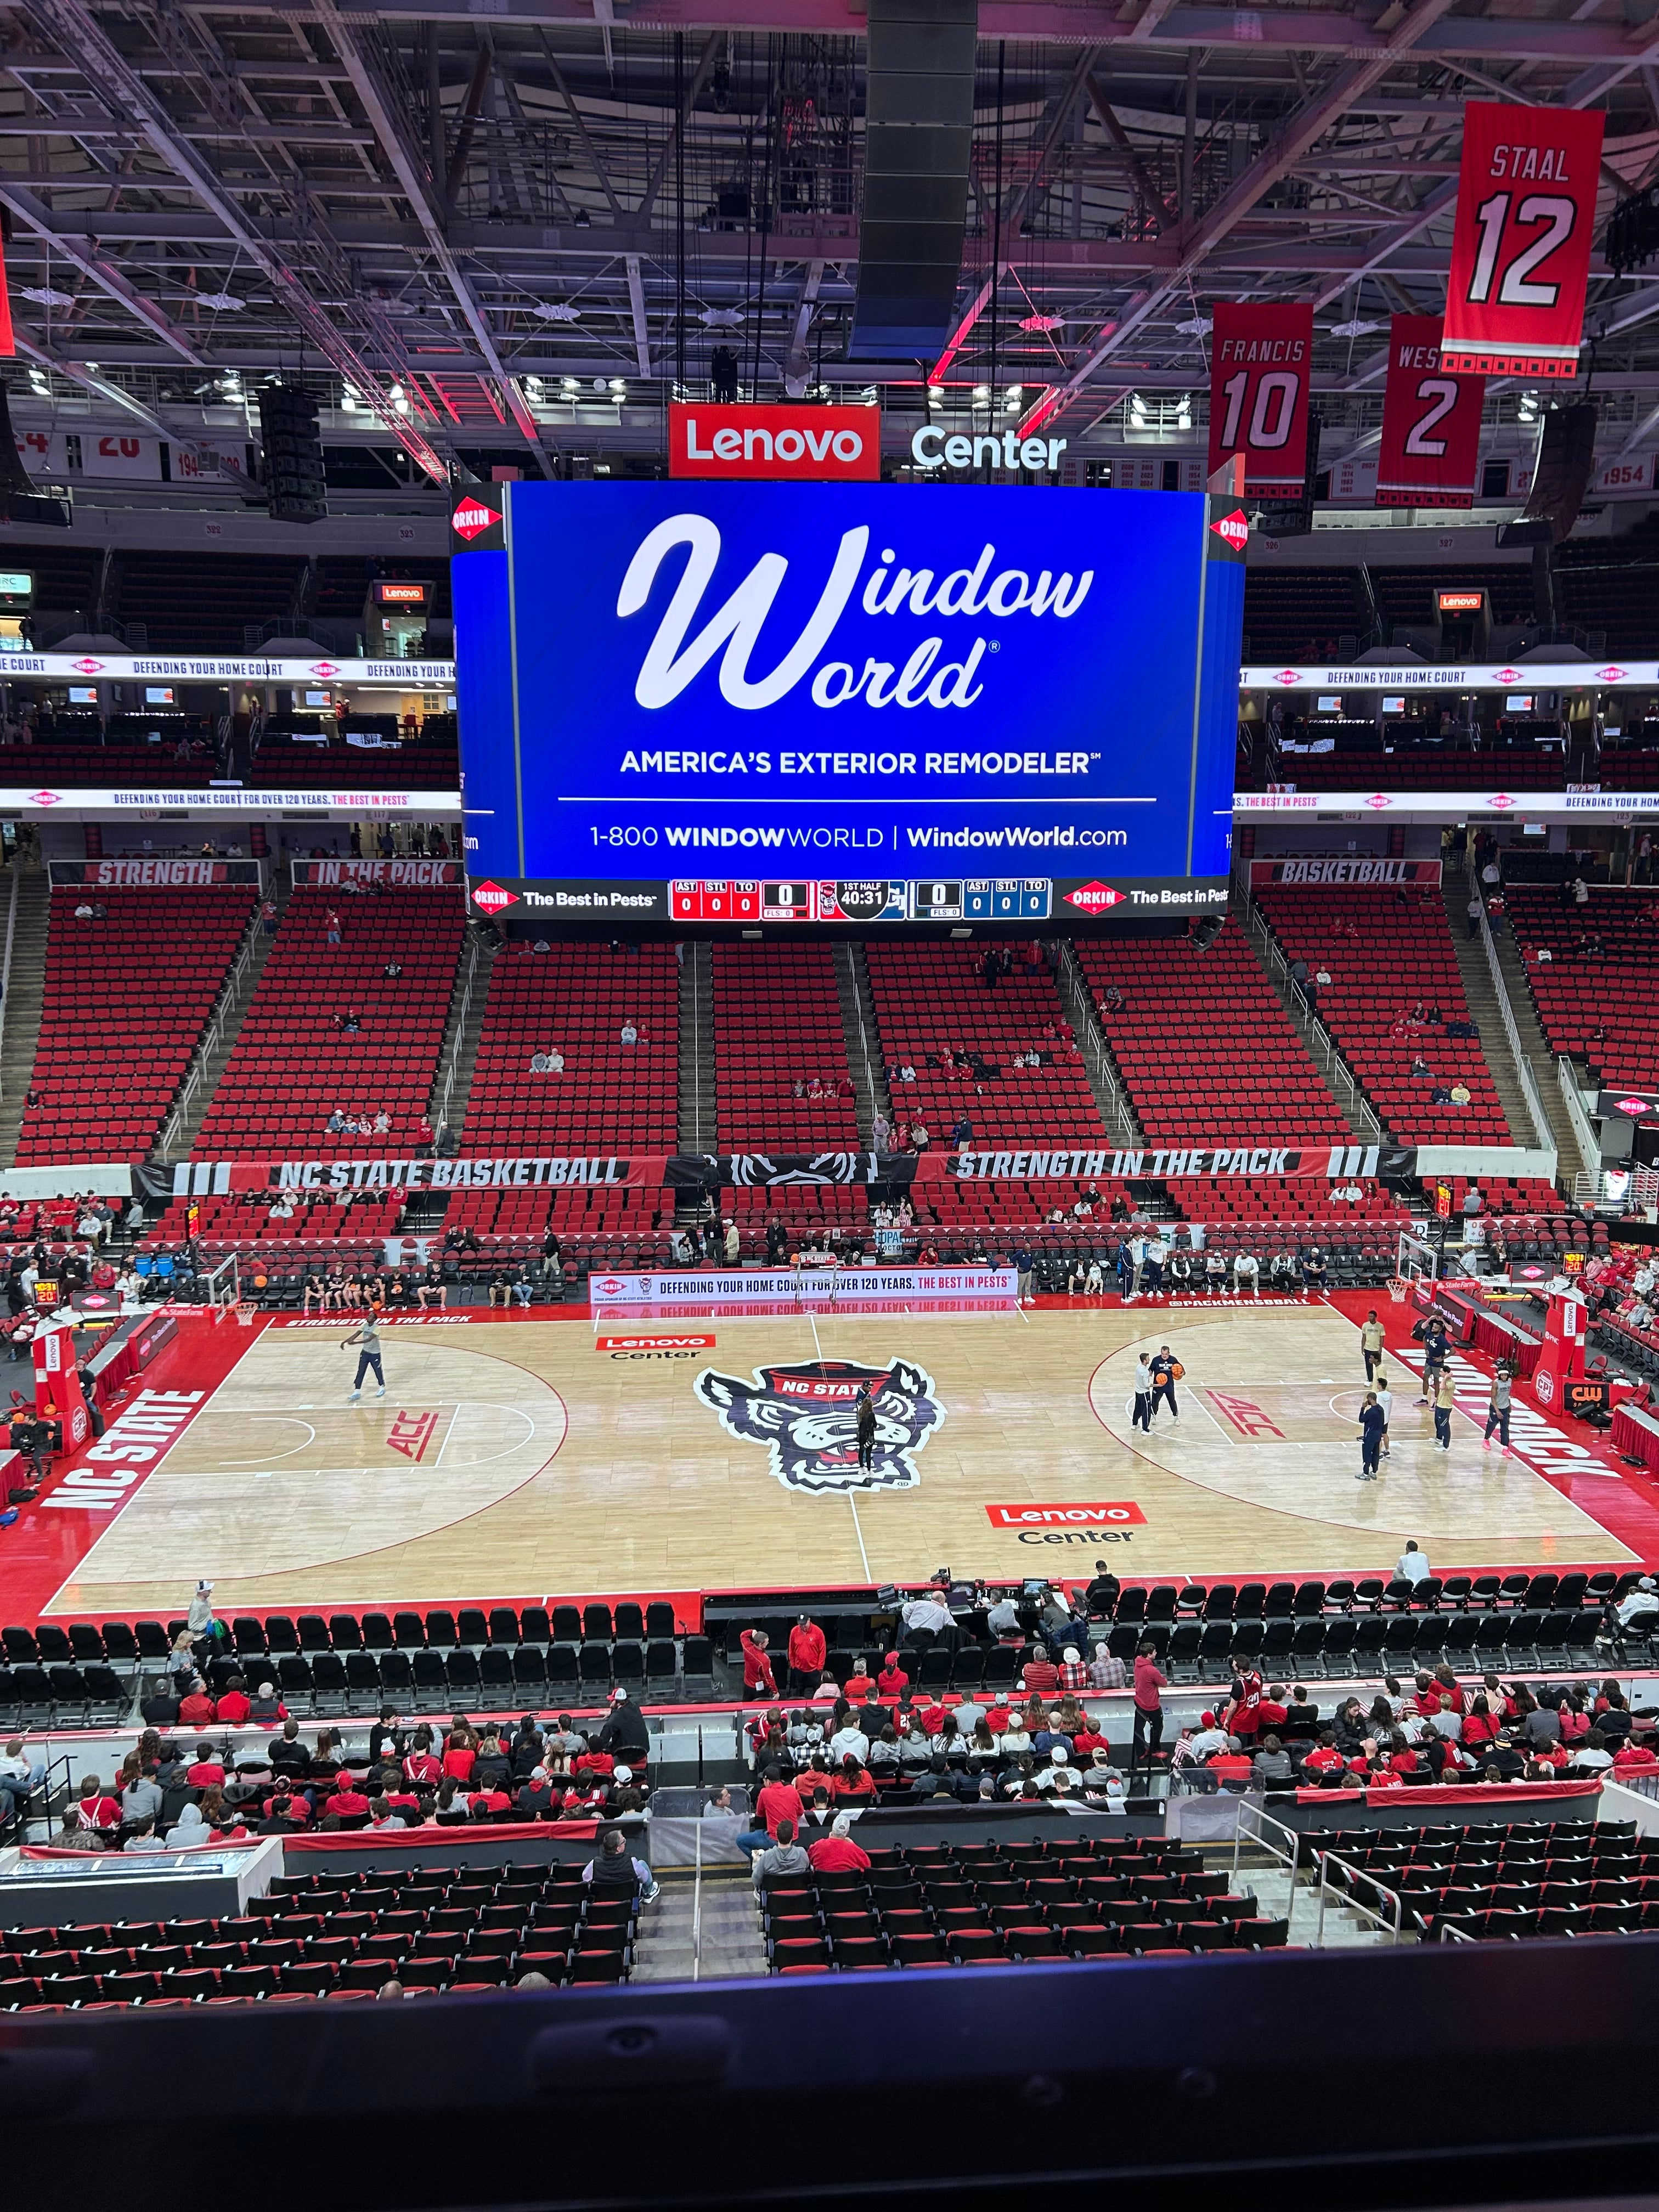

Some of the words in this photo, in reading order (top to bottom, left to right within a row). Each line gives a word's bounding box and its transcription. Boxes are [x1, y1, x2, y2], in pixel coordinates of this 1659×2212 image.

[1491, 145, 1570, 182] STAAL
[1466, 190, 1578, 308] 12
[1220, 339, 1305, 363] FRANCIS
[1220, 371, 1300, 450] 10
[1403, 379, 1459, 456] 2
[686, 420, 863, 462] Lenovo
[911, 425, 1068, 471] Center
[1604, 465, 1644, 484] 1954
[453, 509, 489, 529] ORKIN
[206, 525, 222, 534] 322
[399, 528, 415, 538] 323
[1266, 540, 1278, 549] 326
[1439, 539, 1453, 547] 327
[385, 588, 421, 598] Lenovo
[1443, 596, 1477, 607] Lenovo
[11, 659, 45, 672] COURT
[76, 662, 101, 670] ORKIN
[133, 662, 187, 674] DEFENDING
[190, 662, 216, 674] YOUR
[218, 663, 246, 675] HOME
[249, 663, 283, 675] COURT
[313, 666, 336, 674] ORKIN
[367, 664, 419, 677] DEFENDING
[421, 665, 445, 678] YOUR
[1277, 673, 1299, 681] ORKIN
[1328, 672, 1375, 684] DEFENDING
[1379, 672, 1402, 684] YOUR
[1405, 672, 1432, 684] HOME
[1434, 671, 1466, 683] COURT
[1496, 672, 1519, 680] ORKIN
[1599, 670, 1624, 679] ORKIN
[779, 751, 917, 774] EXTERIOR
[114, 794, 160, 804] DEFENDING
[163, 794, 185, 804] YOUR
[187, 794, 212, 804] HOME
[213, 794, 242, 805] COURT
[245, 794, 261, 805] FOR
[262, 794, 283, 805] OVER
[285, 794, 300, 805] 120
[302, 794, 331, 805] YEARS.
[332, 794, 347, 805] THE
[349, 795, 369, 805] BEST
[371, 795, 380, 805] IN
[1245, 797, 1260, 807] THE
[1261, 797, 1282, 807] BEST
[1283, 797, 1291, 807] IN
[1566, 797, 1612, 807] DEFENDING
[1615, 797, 1638, 807] YOUR
[590, 826, 659, 847] 1-800
[664, 827, 884, 847] WINDOWWORLD
[906, 826, 1127, 847] WindowWorld.com
[98, 862, 215, 884] STRENGTH
[317, 862, 341, 884] IN
[346, 862, 386, 884] THE
[390, 862, 447, 884] PACK
[1280, 861, 1408, 883] BASKETBALL
[676, 882, 696, 891] AST
[706, 883, 726, 892] STL
[738, 883, 754, 891] TO
[843, 882, 859, 891] 1ST
[860, 882, 882, 891] HALF
[969, 882, 988, 891] AST
[997, 881, 1016, 890] STL
[1028, 881, 1043, 890] TO
[475, 889, 508, 905] ORKIN
[522, 892, 554, 906] The
[556, 892, 591, 906] Best
[594, 893, 609, 906] in
[778, 884, 793, 906] 0
[840, 891, 883, 905] 40:31
[932, 884, 946, 905] 0
[1073, 891, 1116, 905] ORKIN
[1130, 890, 1159, 904] The
[1161, 889, 1193, 904] Best
[1194, 889, 1207, 903] in
[682, 898, 692, 911] 0
[712, 898, 722, 911] 0
[741, 898, 751, 911] 0
[972, 896, 982, 910] 0
[1001, 896, 1011, 910] 0
[1029, 896, 1039, 910] 0
[1620, 1102, 1646, 1110] ORKIN
[956, 1150, 1101, 1179] STRENGTH
[1110, 1149, 1144, 1177] IN
[1153, 1149, 1213, 1177] THE
[1217, 1148, 1288, 1176] PACK
[279, 1160, 323, 1189] NC
[329, 1158, 423, 1188] STATE
[431, 1158, 620, 1187] BASKETBALL
[660, 1281, 713, 1294] DEFENDING
[717, 1280, 743, 1293] YOUR
[746, 1280, 774, 1292] HOME
[861, 1278, 878, 1290] 120
[881, 1277, 915, 1289] YEARS.
[918, 1277, 935, 1289] THE
[938, 1276, 961, 1288] BEST
[965, 1276, 975, 1288] IN
[1169, 1299, 1311, 1307] @PACKMENSBBALL
[286, 1318, 369, 1327] STRENGTH
[394, 1316, 427, 1325] THE
[428, 1315, 474, 1323] PACK
[606, 1336, 707, 1348] Lenovo
[610, 1351, 702, 1361] Center
[782, 1381, 810, 1393] NC
[813, 1383, 862, 1395] STAT
[1538, 1379, 1552, 1396] CPI
[1571, 1387, 1602, 1402] CW
[1216, 1392, 1288, 1440] ACC
[85, 1388, 206, 1463] STATE
[386, 1410, 431, 1459] ACC
[41, 1468, 139, 1509] NC
[1000, 1508, 1130, 1523] Lenovo
[1018, 1530, 1135, 1545] Center
[1246, 1691, 1260, 1709] 20
